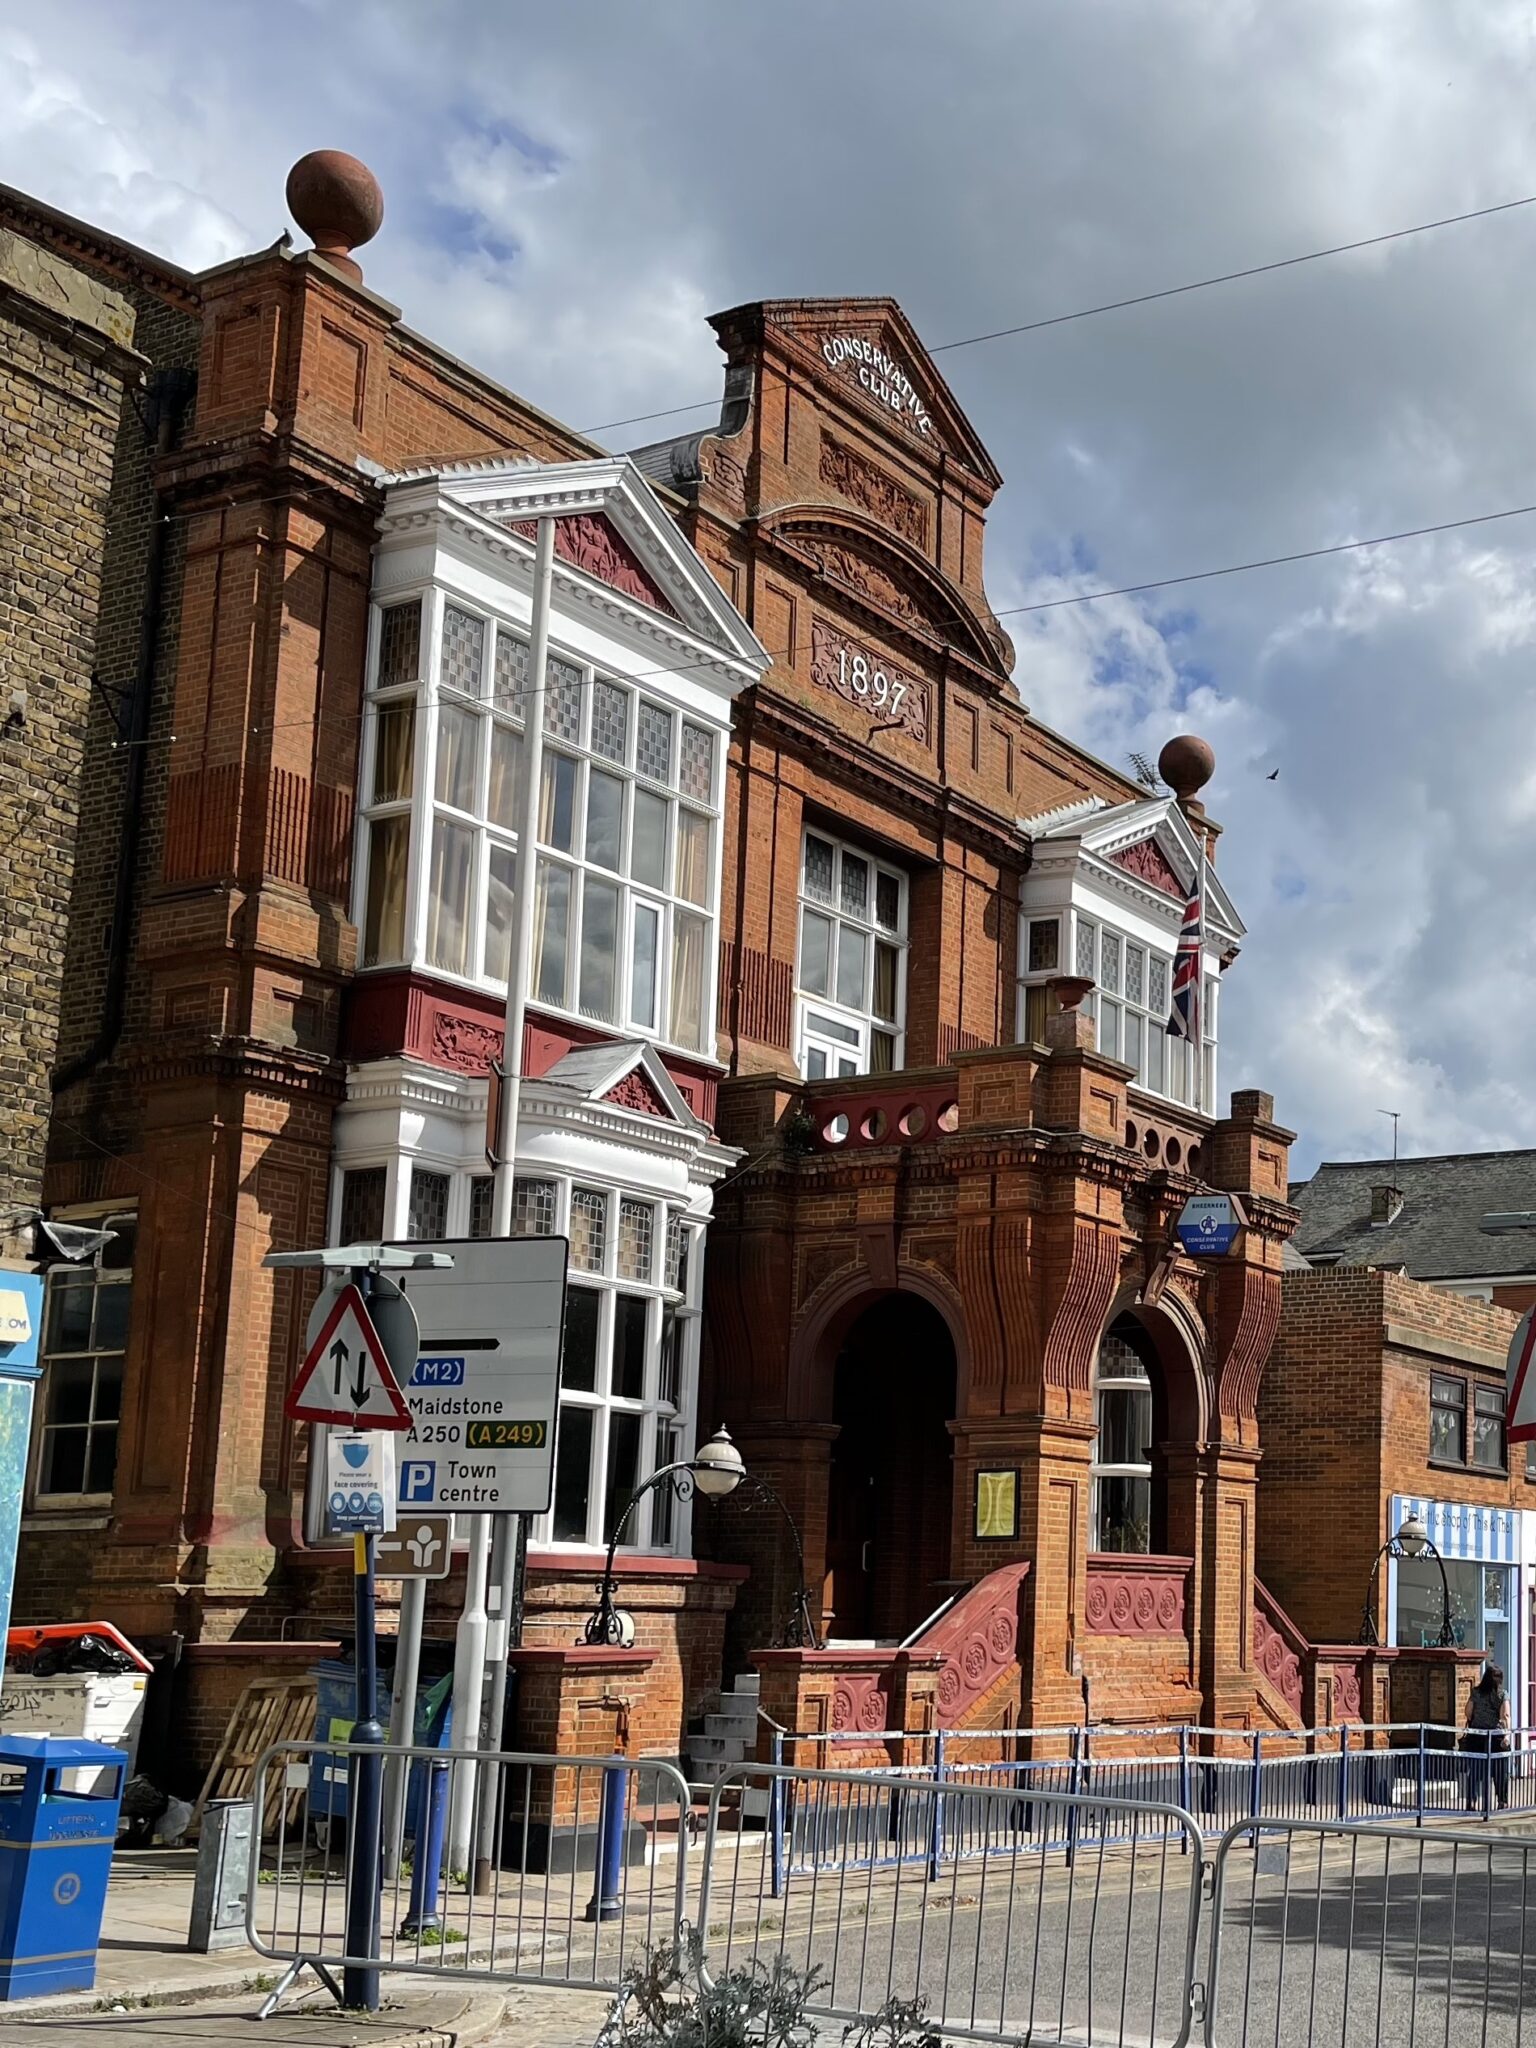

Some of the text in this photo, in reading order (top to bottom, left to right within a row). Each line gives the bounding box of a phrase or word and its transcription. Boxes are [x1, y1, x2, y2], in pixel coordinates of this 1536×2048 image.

[823, 337, 932, 433] CONSERVATIVE
[859, 367, 901, 411] CLUB
[838, 649, 907, 715] 1897
[412, 1361, 461, 1383] (M2)
[409, 1398, 503, 1415] Maidstone
[448, 1461, 496, 1478] Town
[350, 1481, 378, 1489] covering
[407, 1464, 431, 1499] P
[440, 1485, 499, 1501] centre
[1442, 1511, 1460, 1531] Shop
